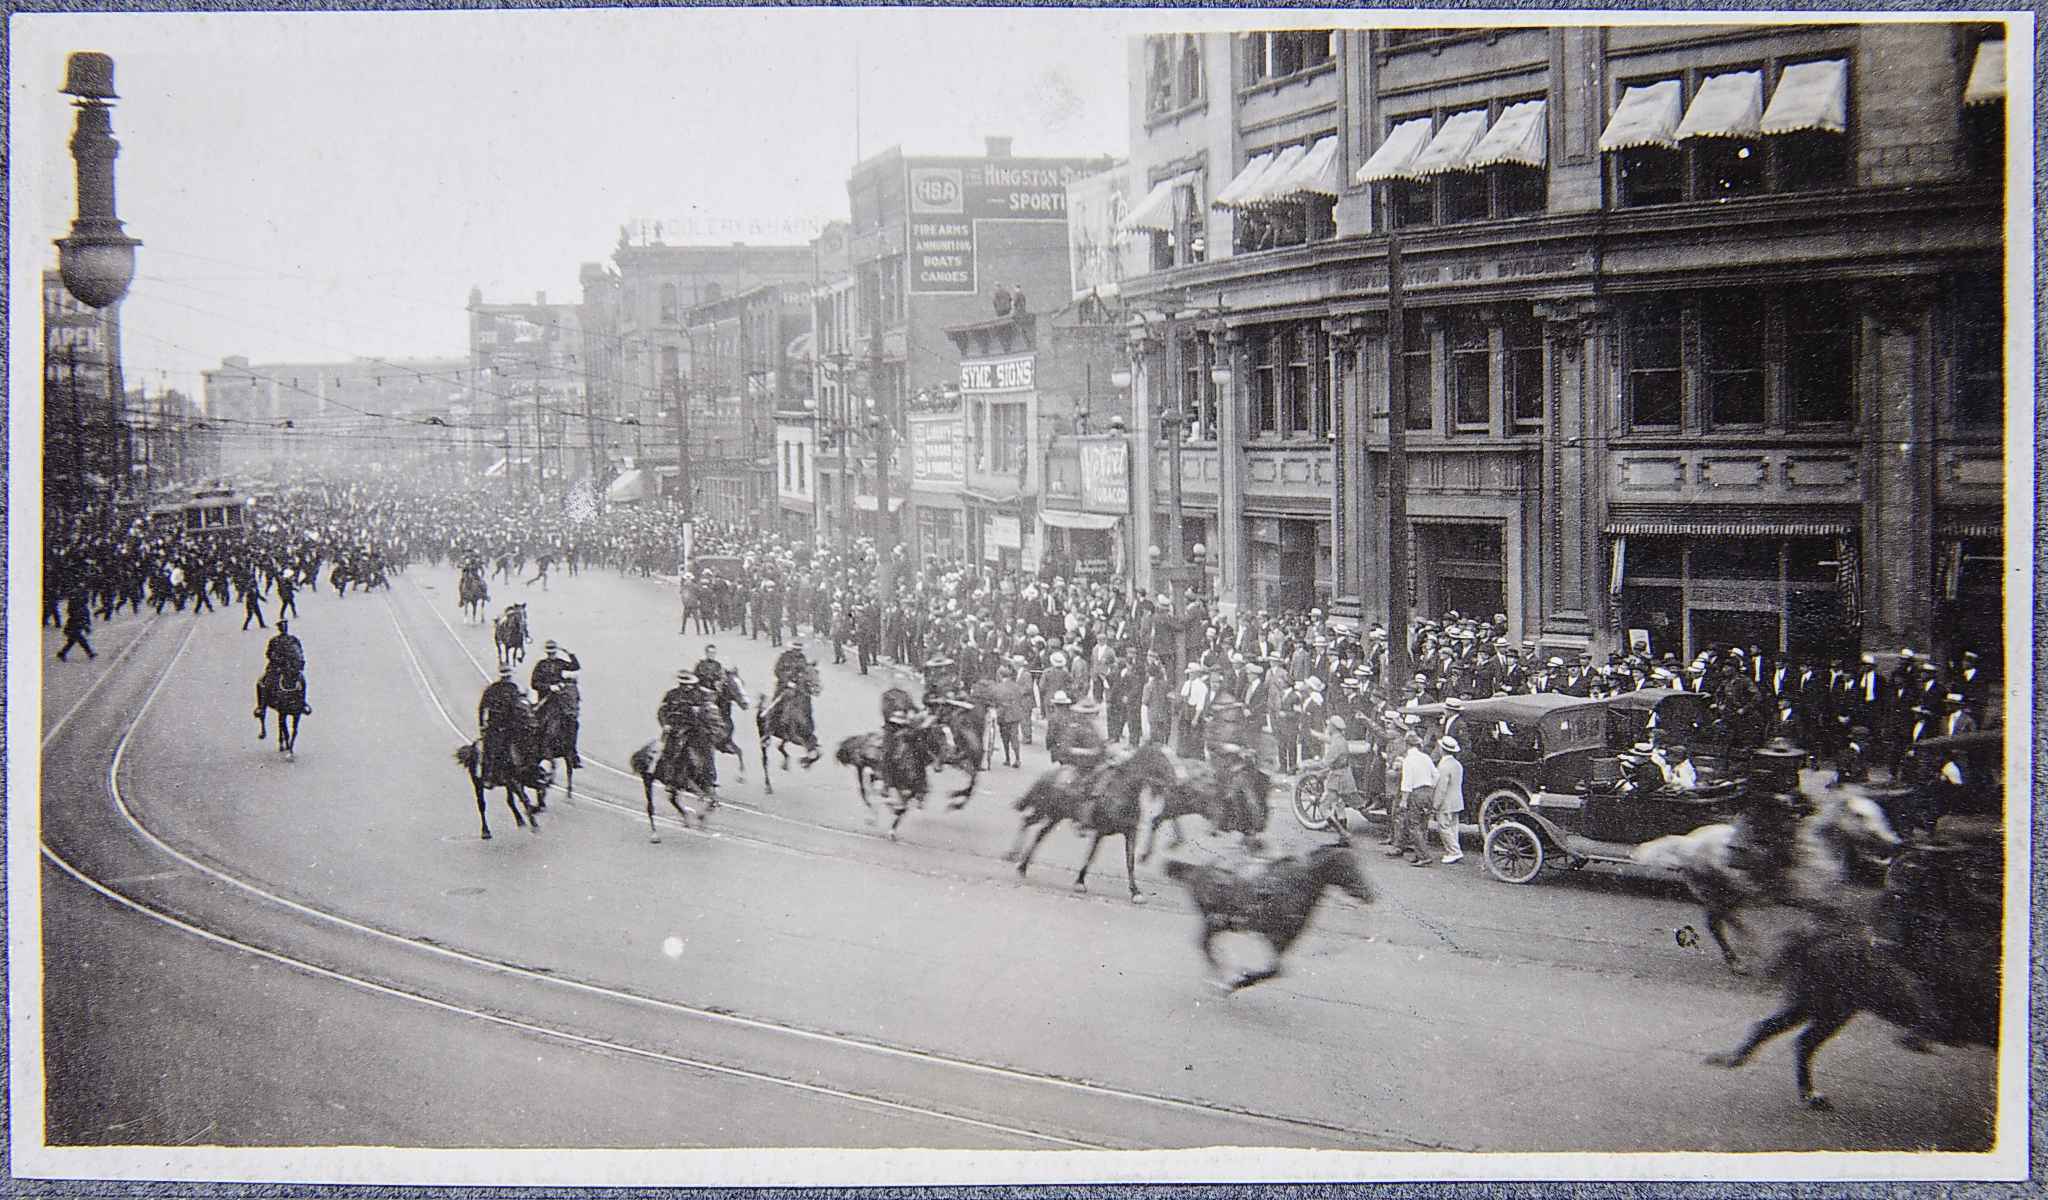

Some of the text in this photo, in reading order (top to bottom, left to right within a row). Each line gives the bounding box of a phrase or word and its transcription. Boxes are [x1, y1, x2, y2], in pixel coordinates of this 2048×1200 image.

[984, 163, 1058, 187] HINGSTON
[923, 255, 962, 268] BOATS
[920, 271, 969, 283] CANOES
[996, 360, 1032, 387] SIGNS
